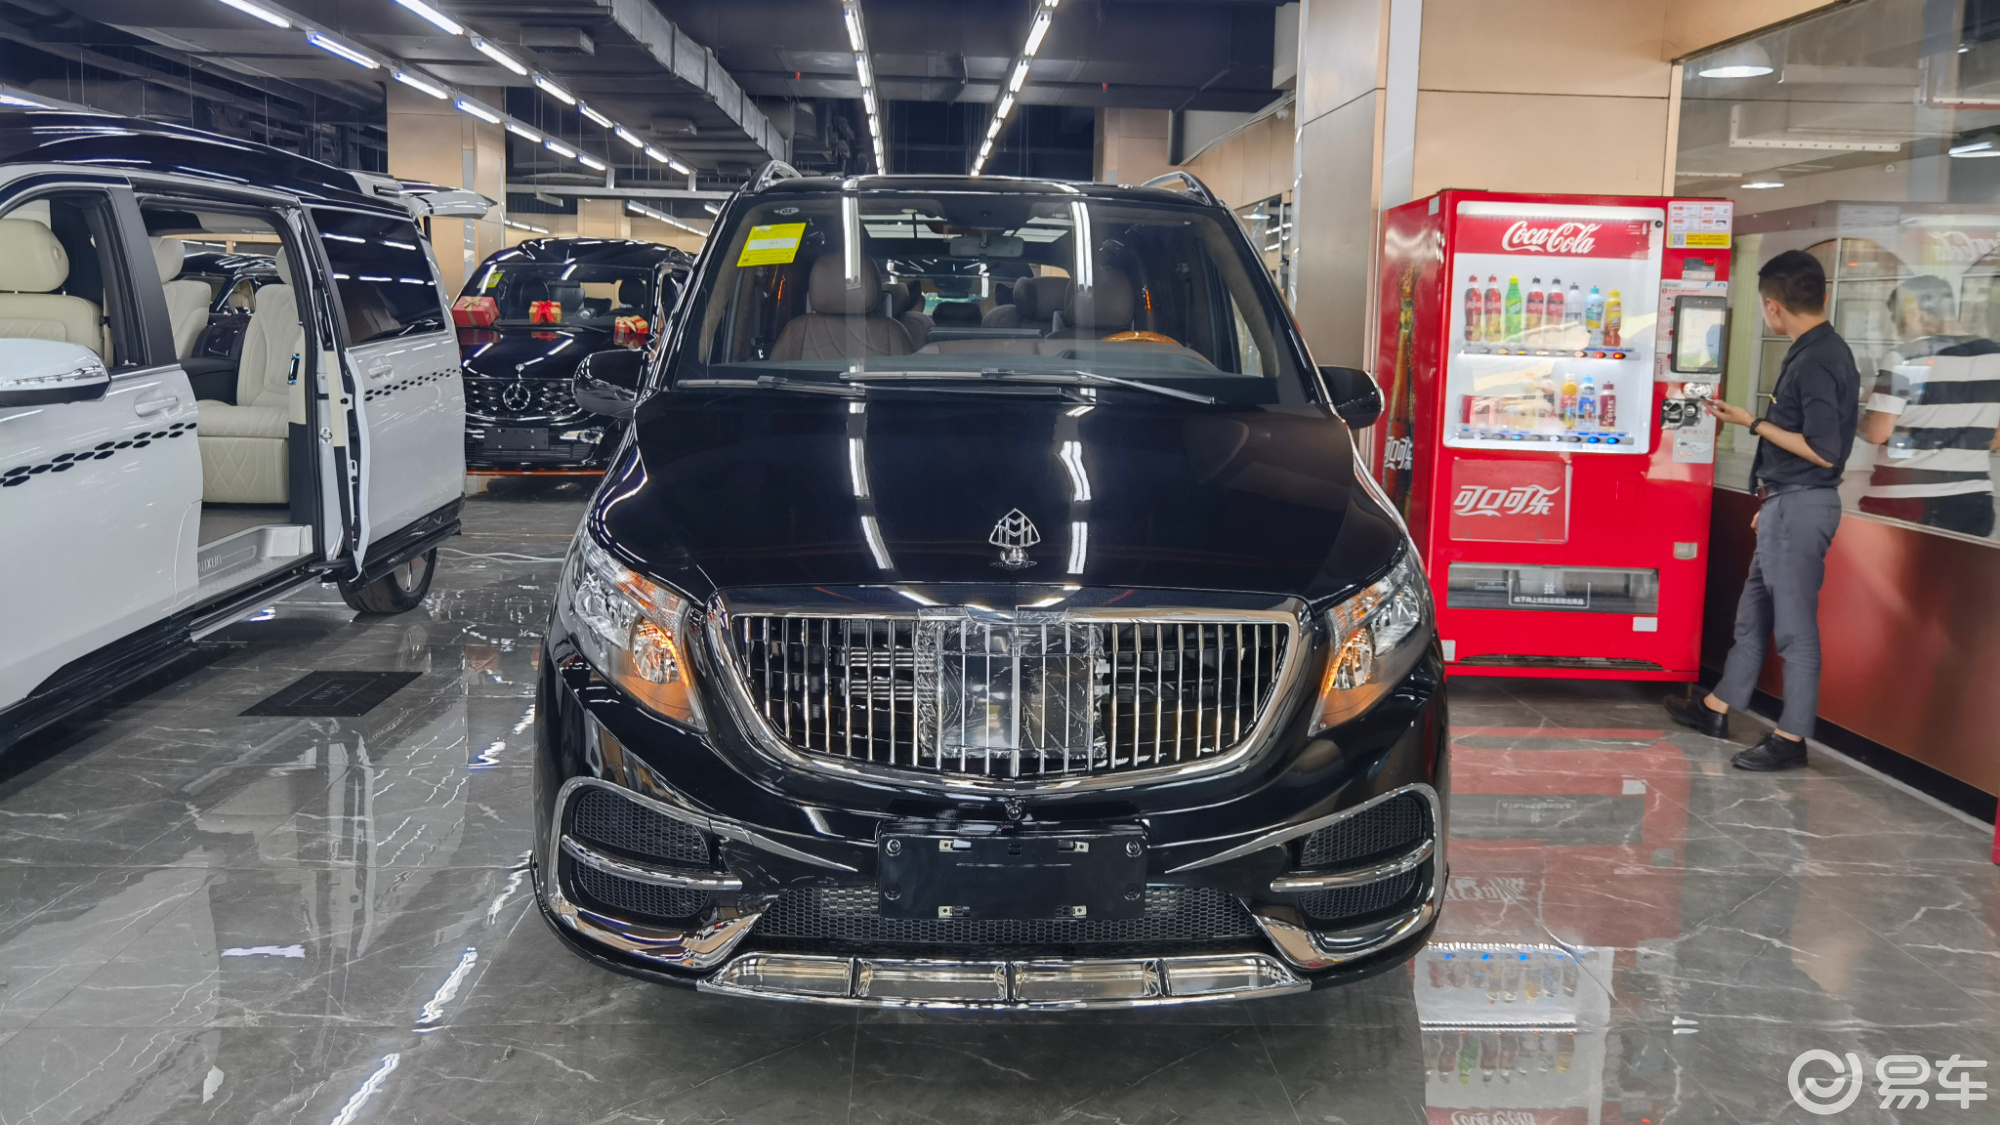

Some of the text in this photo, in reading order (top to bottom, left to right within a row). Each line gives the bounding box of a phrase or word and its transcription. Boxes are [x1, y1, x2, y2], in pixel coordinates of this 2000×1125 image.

[1502, 220, 1602, 254] Coca-Cola
[1453, 484, 1561, 517] 可口可乐
[1543, 582, 1556, 595] 拉
